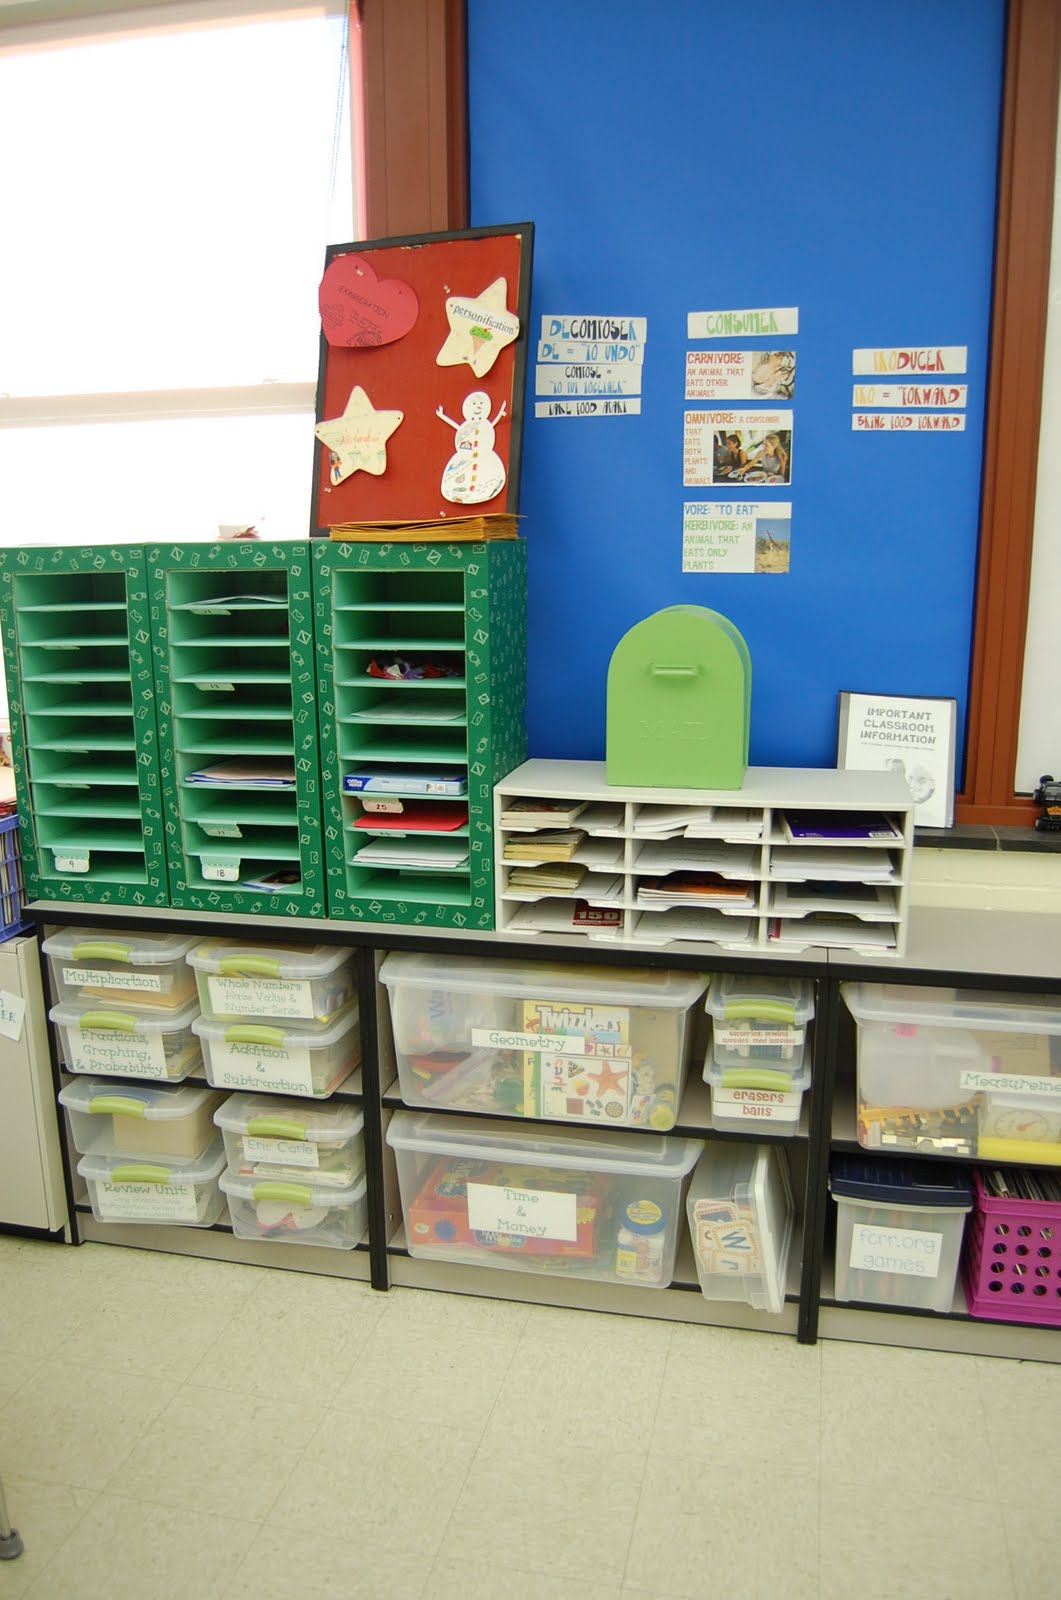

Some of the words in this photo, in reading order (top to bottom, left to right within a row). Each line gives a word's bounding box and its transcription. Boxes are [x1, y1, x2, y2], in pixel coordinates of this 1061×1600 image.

[453, 303, 515, 335] personification
[706, 312, 779, 335] CONSUMER
[549, 319, 637, 341] DECOMPOSER
[687, 353, 745, 364] CARNIVORE:
[873, 350, 945, 371] PRODUCER
[565, 366, 601, 379] COMPOSE
[726, 368, 745, 376] THAT
[686, 379, 704, 387] EATS
[706, 379, 728, 387] OTHER
[549, 403, 571, 416] TAKE
[576, 402, 597, 415] FOOD
[685, 413, 736, 424] OMNIVORE:
[746, 416, 780, 424] CONSUMER
[857, 415, 885, 429] BRING
[890, 416, 912, 429] FOOD
[918, 416, 960, 429] FORWARD
[684, 504, 711, 515] VORE:
[685, 520, 739, 531] HERBIVORE:
[741, 522, 752, 531] AN
[684, 535, 713, 544] ANIMAL
[718, 535, 740, 544] THAT
[684, 548, 704, 557] EATS
[707, 548, 728, 557] ONLY
[684, 561, 714, 570] PLANTS
[867, 707, 931, 721] IMPORTANT
[863, 719, 934, 733] CLASSROOM
[860, 731, 936, 745] INFORMATION
[68, 860, 75, 868] 9
[216, 868, 225, 878] 18
[577, 911, 618, 920] 150
[64, 970, 160, 990] Multiplication
[217, 979, 249, 989] Whole
[225, 991, 252, 1001] Place
[256, 993, 285, 1003] Value
[288, 994, 297, 1003] &
[225, 1003, 266, 1014] Number
[268, 1005, 300, 1016] Sense
[80, 1029, 149, 1045] Fractions,
[489, 1032, 566, 1051] Geometry
[83, 1045, 151, 1062] Graphing,
[229, 1043, 290, 1060] Addition
[75, 1060, 85, 1070] &
[89, 1060, 163, 1077] Probability
[255, 1061, 266, 1073] &
[223, 1074, 308, 1093] Subtraction
[733, 1090, 785, 1103] erasers
[743, 1105, 772, 1117] balls
[247, 1139, 272, 1152] Eric
[277, 1141, 313, 1154] Carle
[103, 1182, 150, 1194] Review
[155, 1184, 188, 1195] Unit
[503, 1188, 539, 1204] Time
[516, 1205, 526, 1217] &
[496, 1218, 547, 1237] Money
[860, 1229, 935, 1254] fcrr.org
[863, 1255, 926, 1273] games
